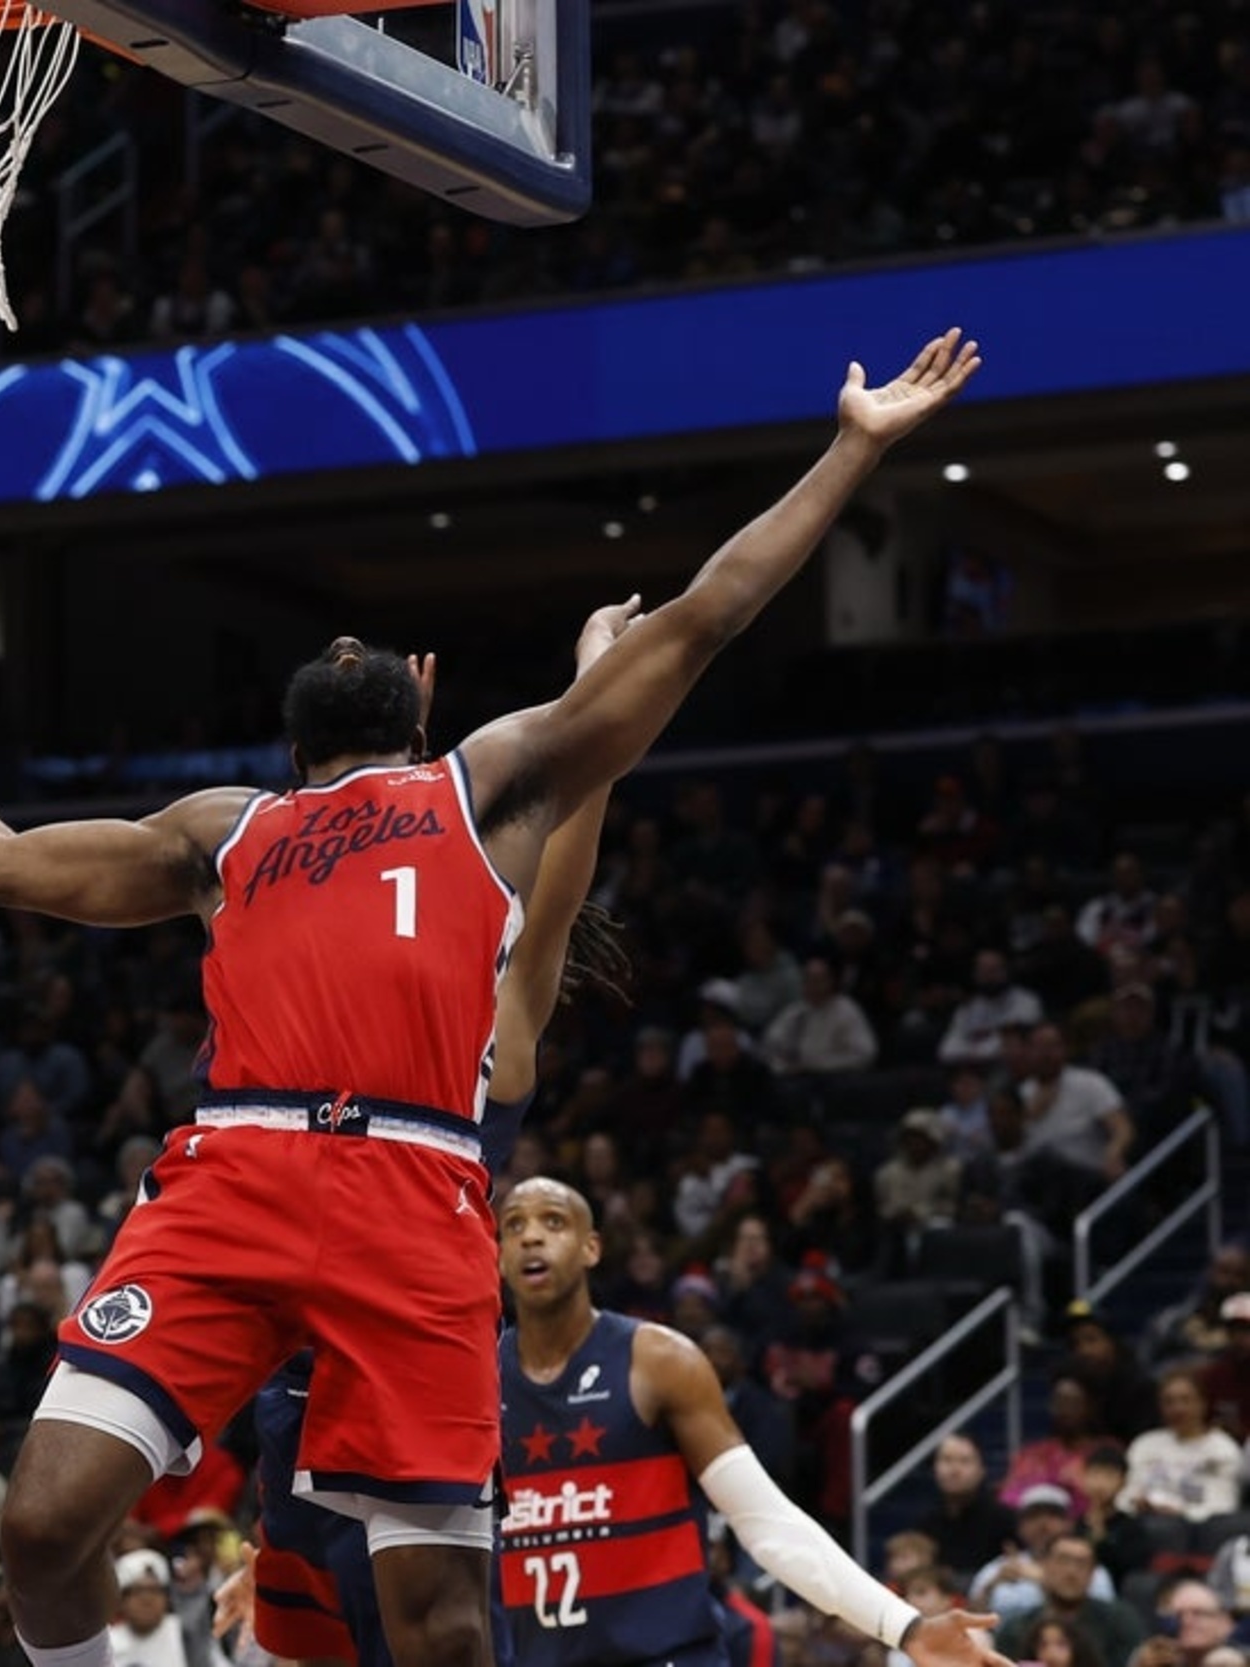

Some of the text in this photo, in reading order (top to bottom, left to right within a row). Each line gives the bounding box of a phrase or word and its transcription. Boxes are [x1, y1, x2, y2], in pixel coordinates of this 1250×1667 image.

[298, 800, 381, 838] Los
[244, 805, 445, 909] Angeles
[380, 866, 416, 938] 1
[317, 1102, 361, 1126] Cps
[524, 1552, 587, 1627] 22
